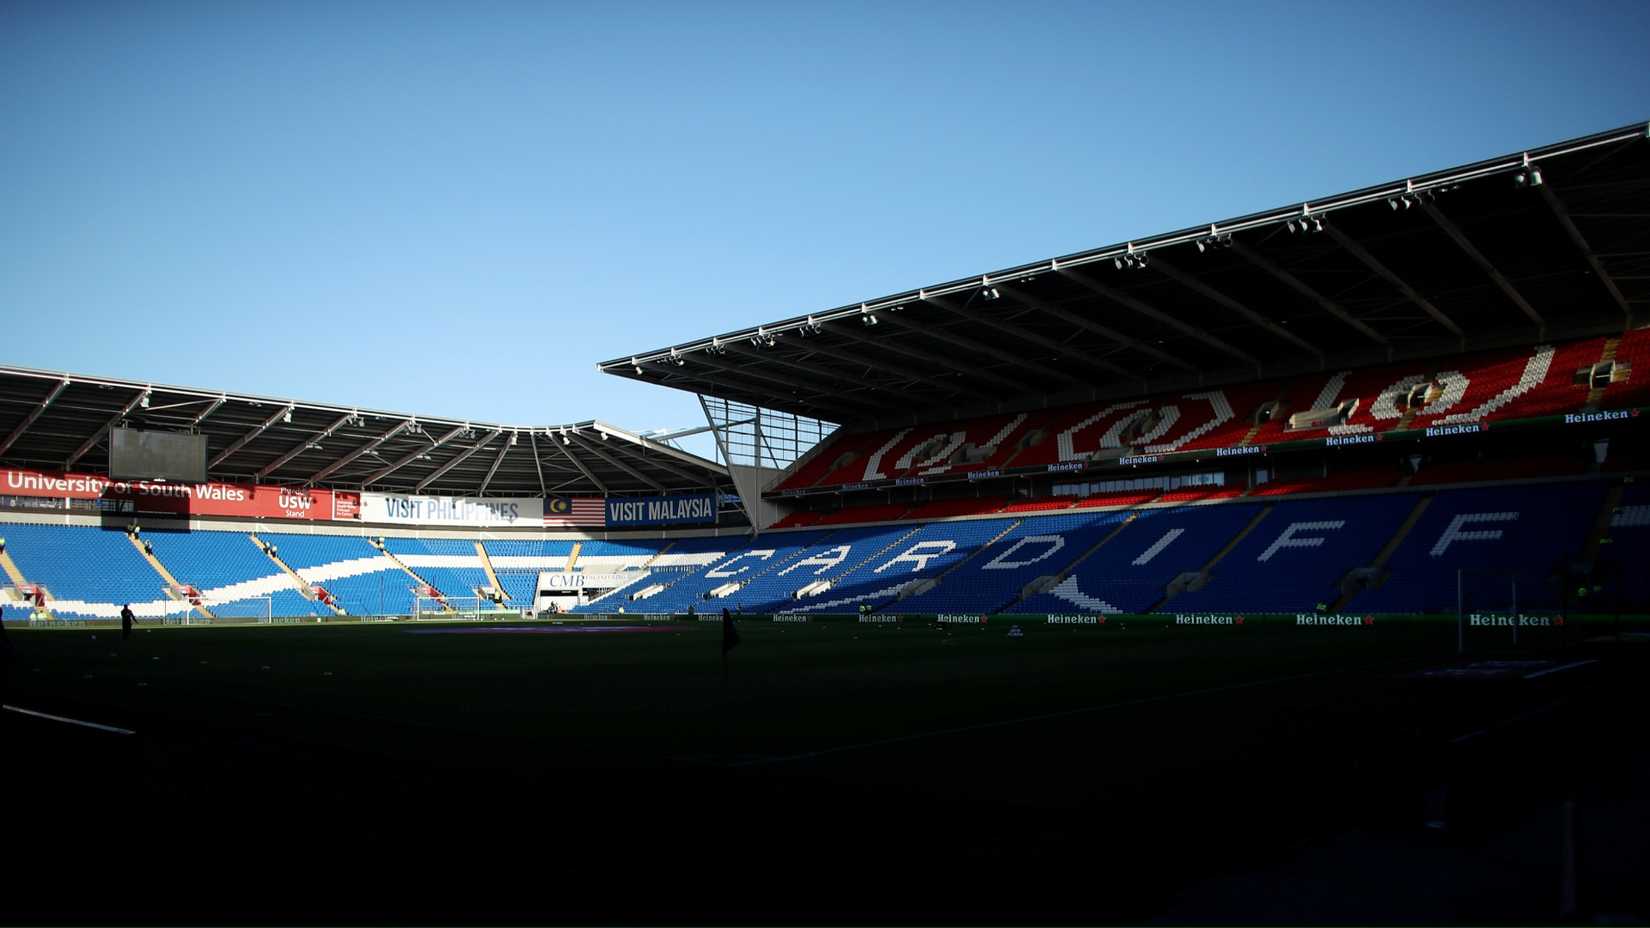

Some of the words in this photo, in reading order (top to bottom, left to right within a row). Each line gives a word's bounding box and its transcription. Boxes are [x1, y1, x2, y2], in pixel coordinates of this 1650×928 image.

[1565, 410, 1628, 423] Heineken
[1426, 424, 1480, 437] Heineken
[1326, 435, 1374, 446] Heineken
[1216, 446, 1260, 456] Heineken
[1119, 456, 1157, 465] Heineken
[1048, 463, 1083, 472] Heineken
[968, 470, 1000, 480] Heineken
[8, 471, 110, 497] University
[114, 481, 133, 494] of
[139, 481, 192, 497] South
[195, 484, 244, 501] Wales
[279, 495, 312, 509] USW
[286, 509, 305, 518] Stand
[386, 499, 423, 519] VISIT
[610, 502, 645, 521] VISIT
[648, 498, 712, 520] MALAYSIA
[550, 575, 585, 587] CMB
[772, 614, 806, 623] Heineken
[859, 614, 897, 623] Heineken
[937, 614, 980, 623] Heineken
[1047, 614, 1097, 624] Heineken
[1176, 614, 1233, 625] Heineken
[1296, 614, 1362, 625] Heineken
[1469, 614, 1551, 626] Heineken
